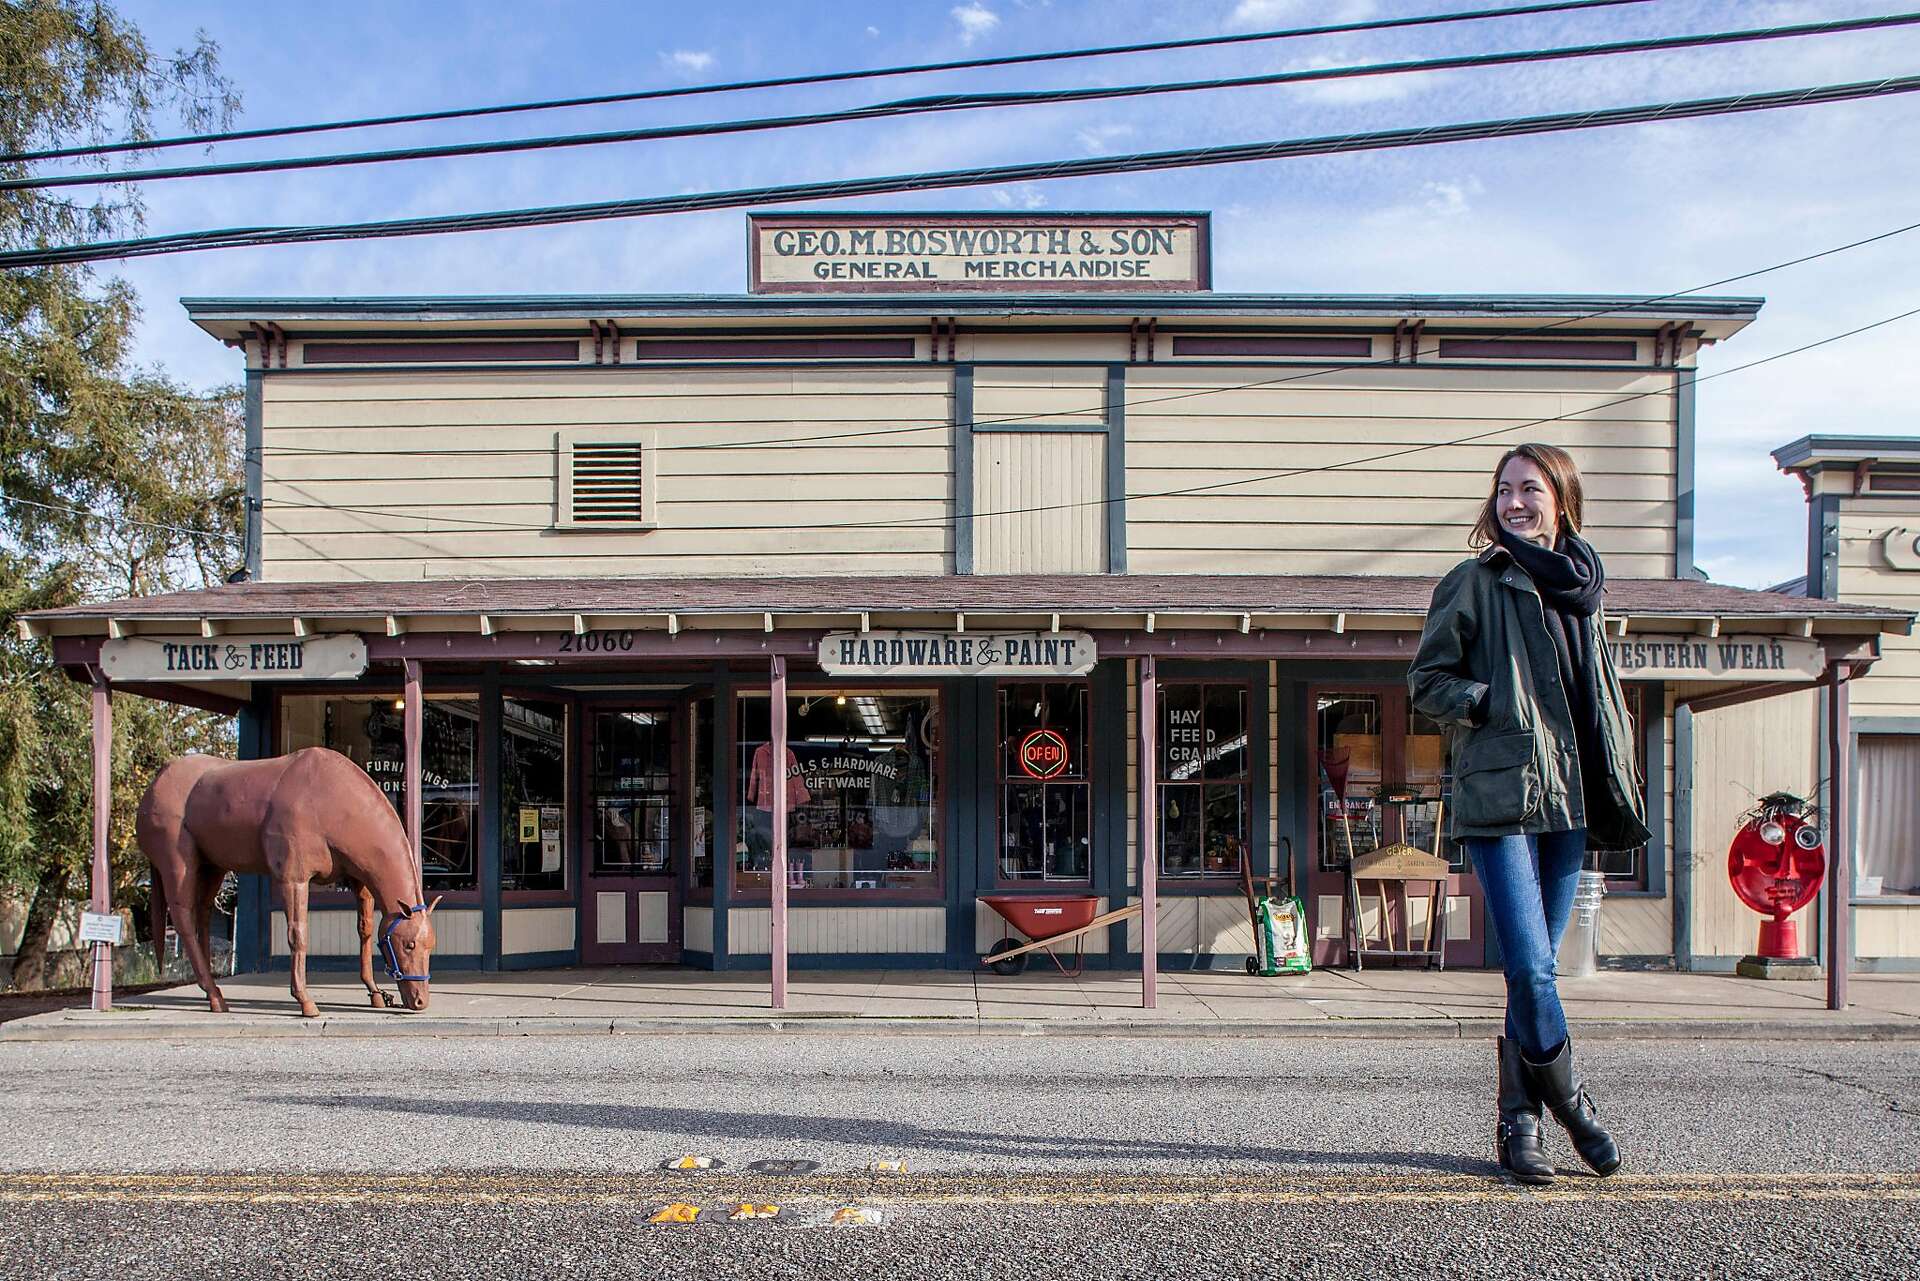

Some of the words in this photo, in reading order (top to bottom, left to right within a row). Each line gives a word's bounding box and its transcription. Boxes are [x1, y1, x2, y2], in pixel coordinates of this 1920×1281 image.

[1079, 230, 1104, 256] &
[1109, 229, 1174, 256] SON
[813, 261, 937, 280] GENERAL
[964, 260, 1151, 279] MERCHANDISE
[559, 630, 633, 653] 21060
[163, 643, 219, 671] TACK
[224, 644, 247, 671] &
[250, 642, 304, 671] FEED
[839, 638, 973, 667] HARDWARE
[975, 639, 1002, 666] &
[1004, 639, 1076, 666] PAINT
[1717, 643, 1785, 669] WEAR
[1170, 709, 1201, 724] HAY
[1171, 728, 1216, 743] FEED
[1027, 746, 1060, 761] OPEN
[1169, 746, 1221, 761] GRAIN
[366, 760, 449, 789] FURNIINGS
[785, 759, 817, 780] OOLS
[821, 757, 830, 769] &
[833, 757, 898, 780] HARDWARE
[805, 776, 871, 789] GIFTWARE
[1328, 801, 1371, 809] ENRANCE
[1386, 846, 1414, 857] GEYER
